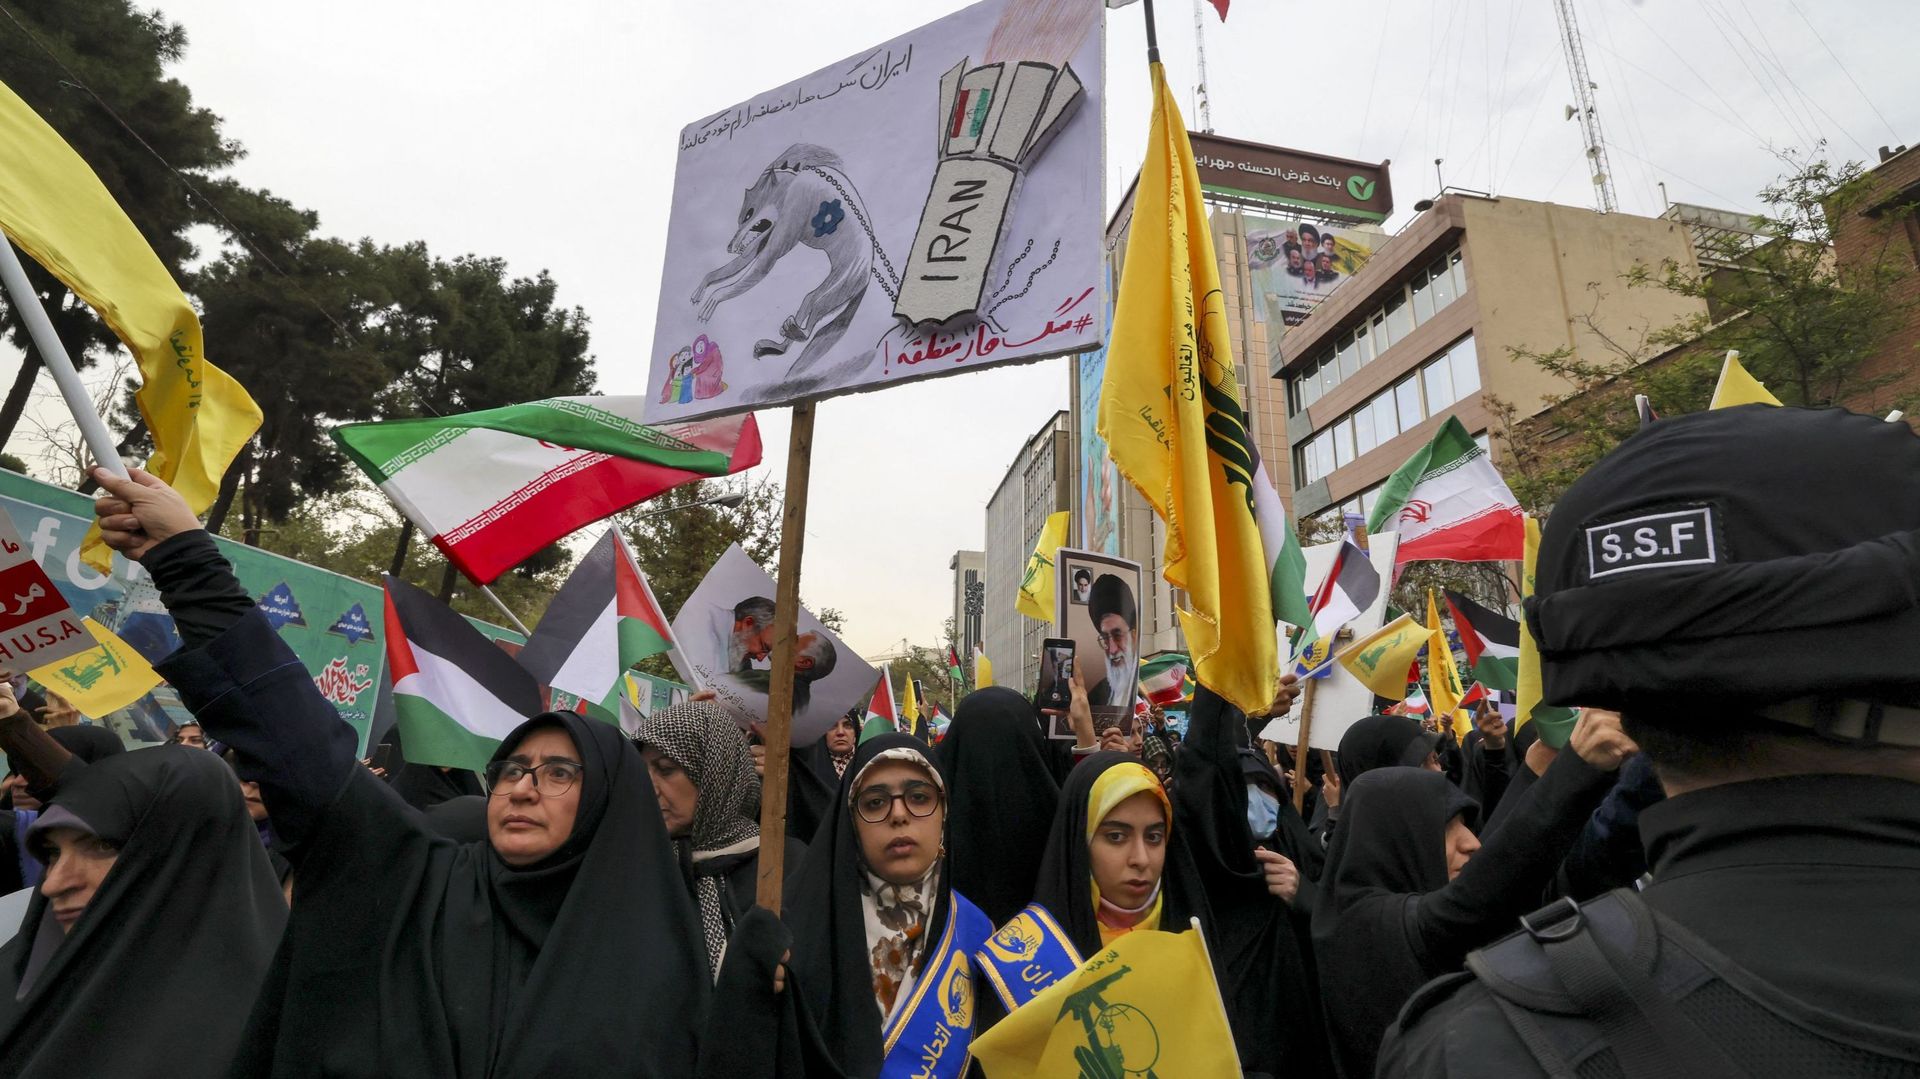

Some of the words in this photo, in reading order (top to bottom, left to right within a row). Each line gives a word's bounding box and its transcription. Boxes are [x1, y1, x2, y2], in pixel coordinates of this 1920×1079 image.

[859, 43, 913, 91] ایران
[1208, 158, 1235, 170] مهر
[1237, 162, 1282, 178] الحسنه
[1282, 168, 1311, 183] قرض
[1312, 174, 1342, 190] بانک
[920, 179, 988, 281] IRAN
[955, 324, 1000, 363] هار
[1178, 344, 1196, 402] الغالبون
[1601, 521, 1695, 563] S.S.F
[11, 618, 83, 654] U.S.A
